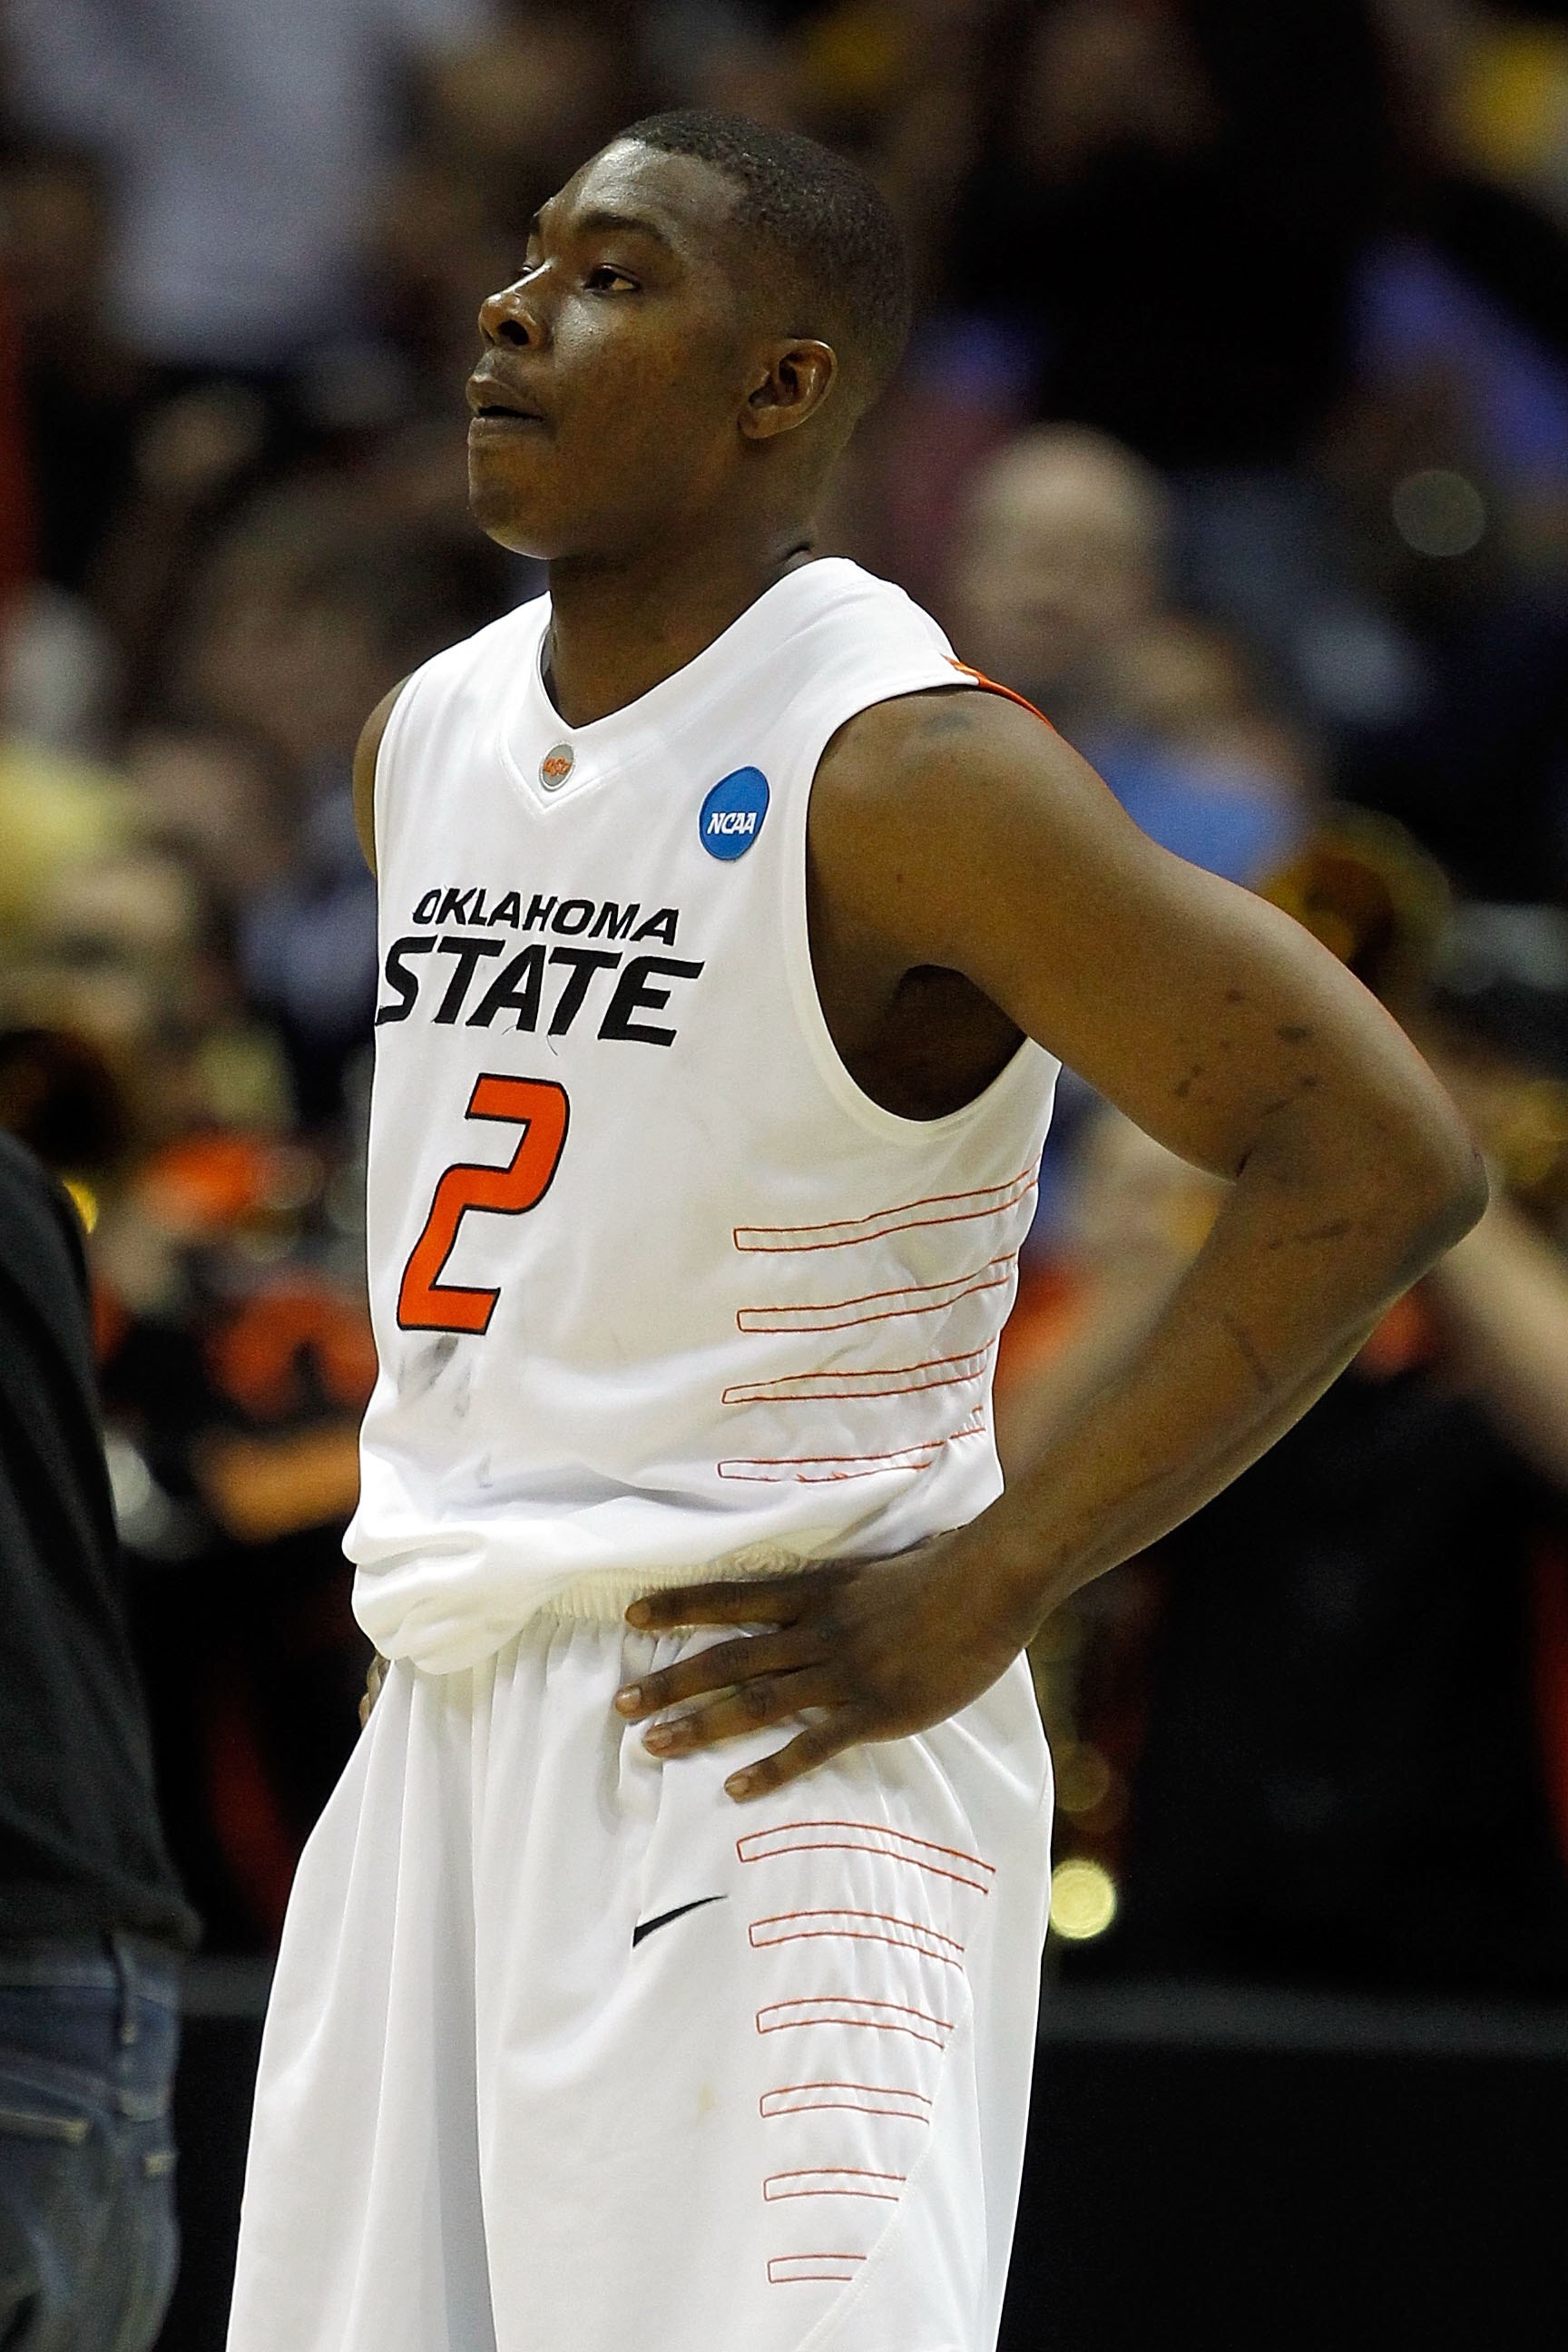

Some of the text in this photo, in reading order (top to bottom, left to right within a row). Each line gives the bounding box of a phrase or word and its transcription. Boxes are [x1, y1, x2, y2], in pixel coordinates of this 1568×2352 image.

[706, 811, 757, 835] NCAA
[412, 886, 680, 947] OKLAHOMA
[375, 935, 705, 1047] STATE
[397, 1073, 571, 1336] 2
